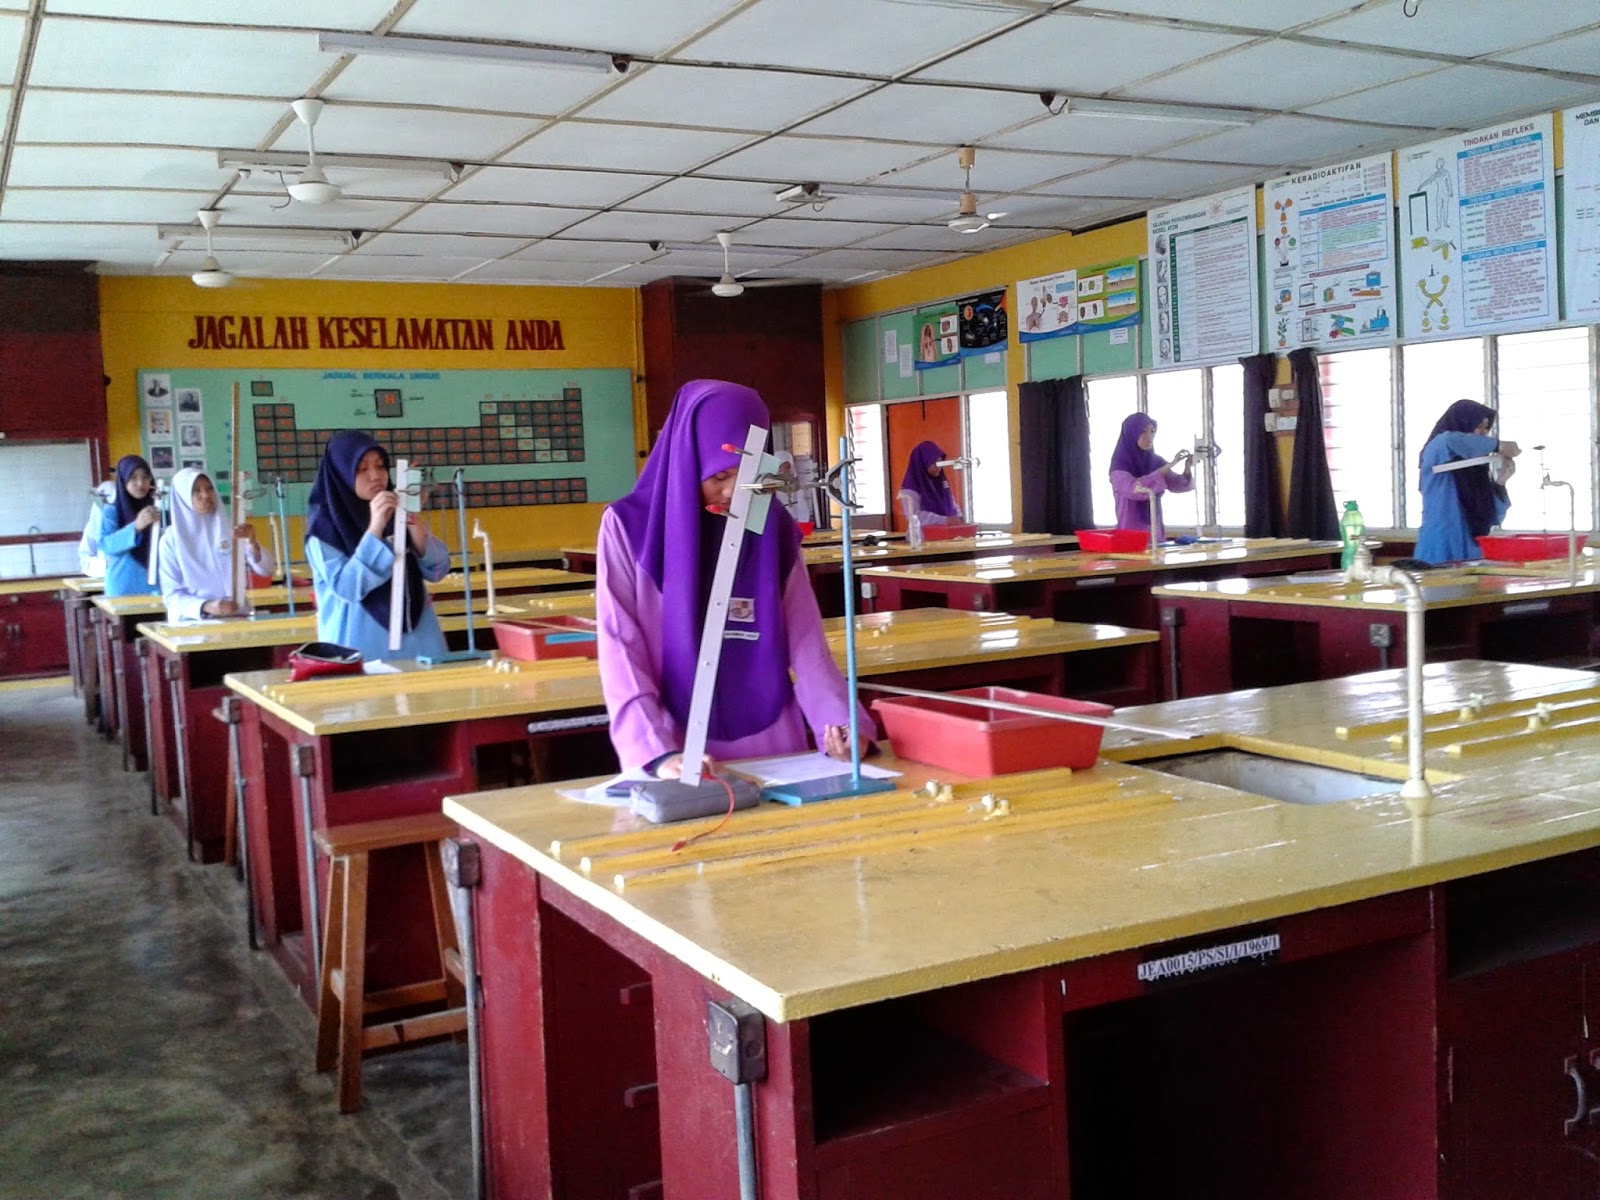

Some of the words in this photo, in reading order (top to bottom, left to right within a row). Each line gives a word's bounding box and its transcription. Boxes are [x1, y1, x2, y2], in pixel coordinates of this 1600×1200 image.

[1463, 132, 1499, 147] TINDAKAN
[1502, 123, 1535, 138] REFLEKS
[1291, 161, 1362, 185] KERADIOAKTIFAN
[188, 315, 309, 349] JAGALAH
[318, 316, 494, 350] KESELAMATAN
[505, 319, 566, 350] ANDA
